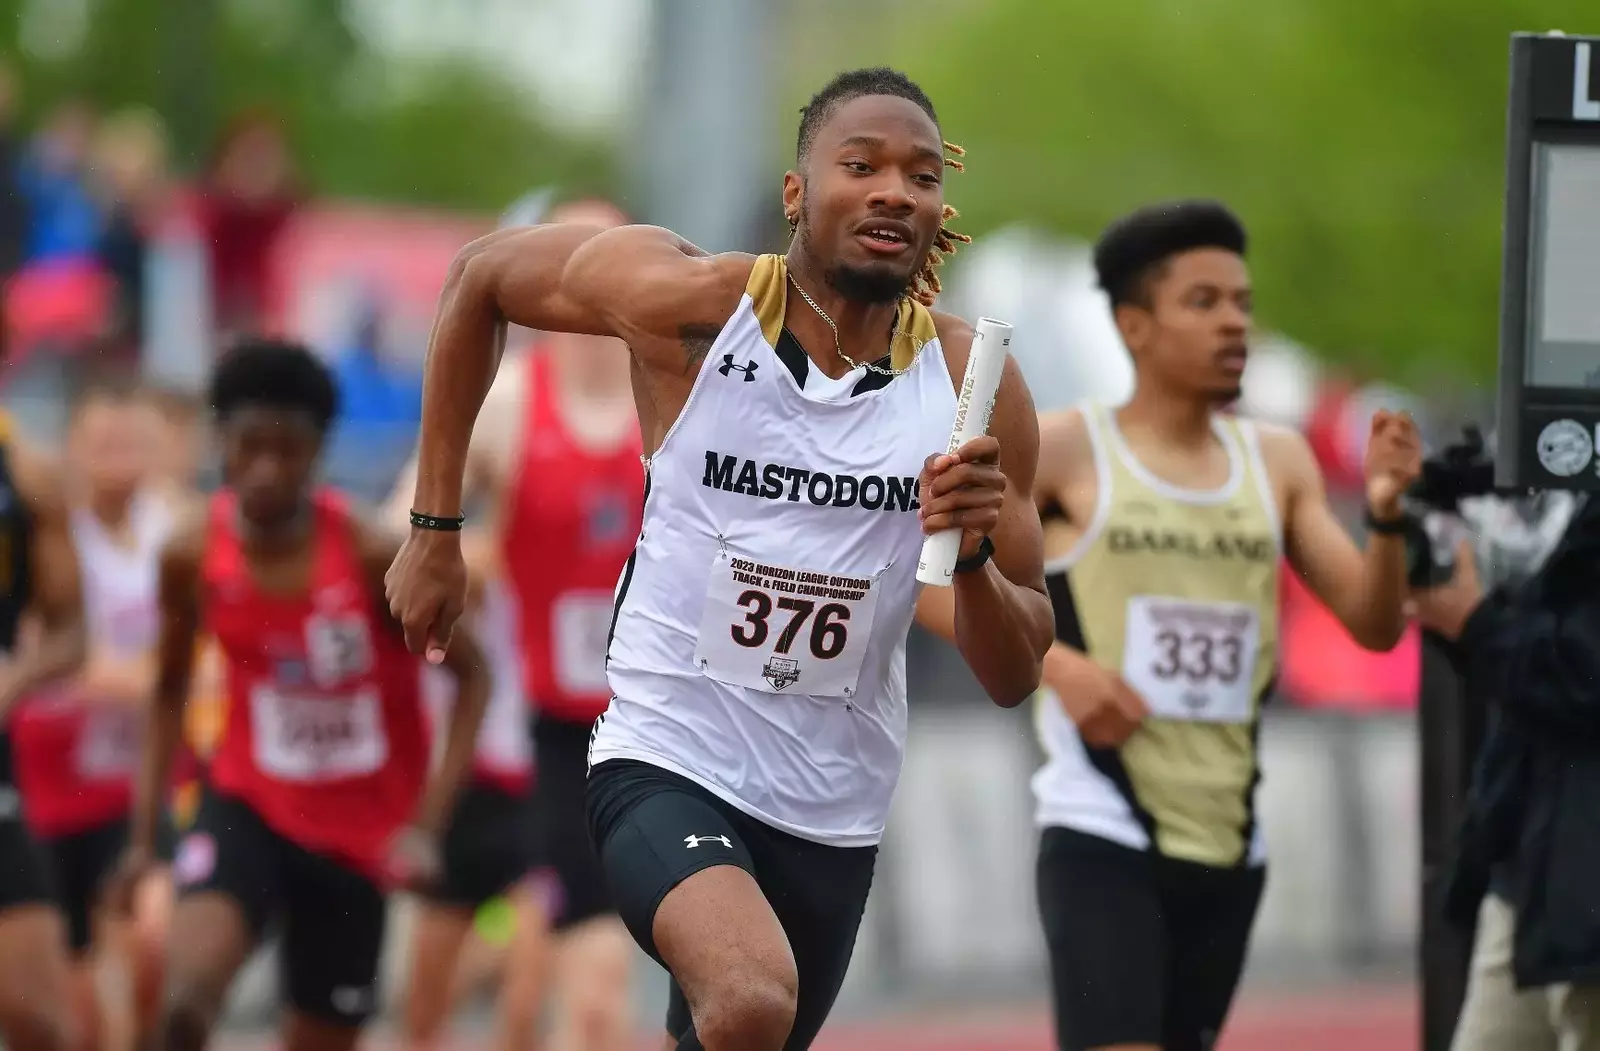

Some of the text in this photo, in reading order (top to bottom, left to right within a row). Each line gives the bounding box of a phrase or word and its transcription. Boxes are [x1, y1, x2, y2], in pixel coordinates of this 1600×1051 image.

[953, 377, 975, 433] WAYNE
[1107, 526, 1272, 562] OAKLAND
[730, 557, 871, 590] 2023 HORIZON LEAGUE OUTDOOR
[732, 570, 865, 601] TRACK & FIELD CHAMPIONSHIP
[730, 589, 851, 660] 376
[1152, 631, 1244, 686] 333
